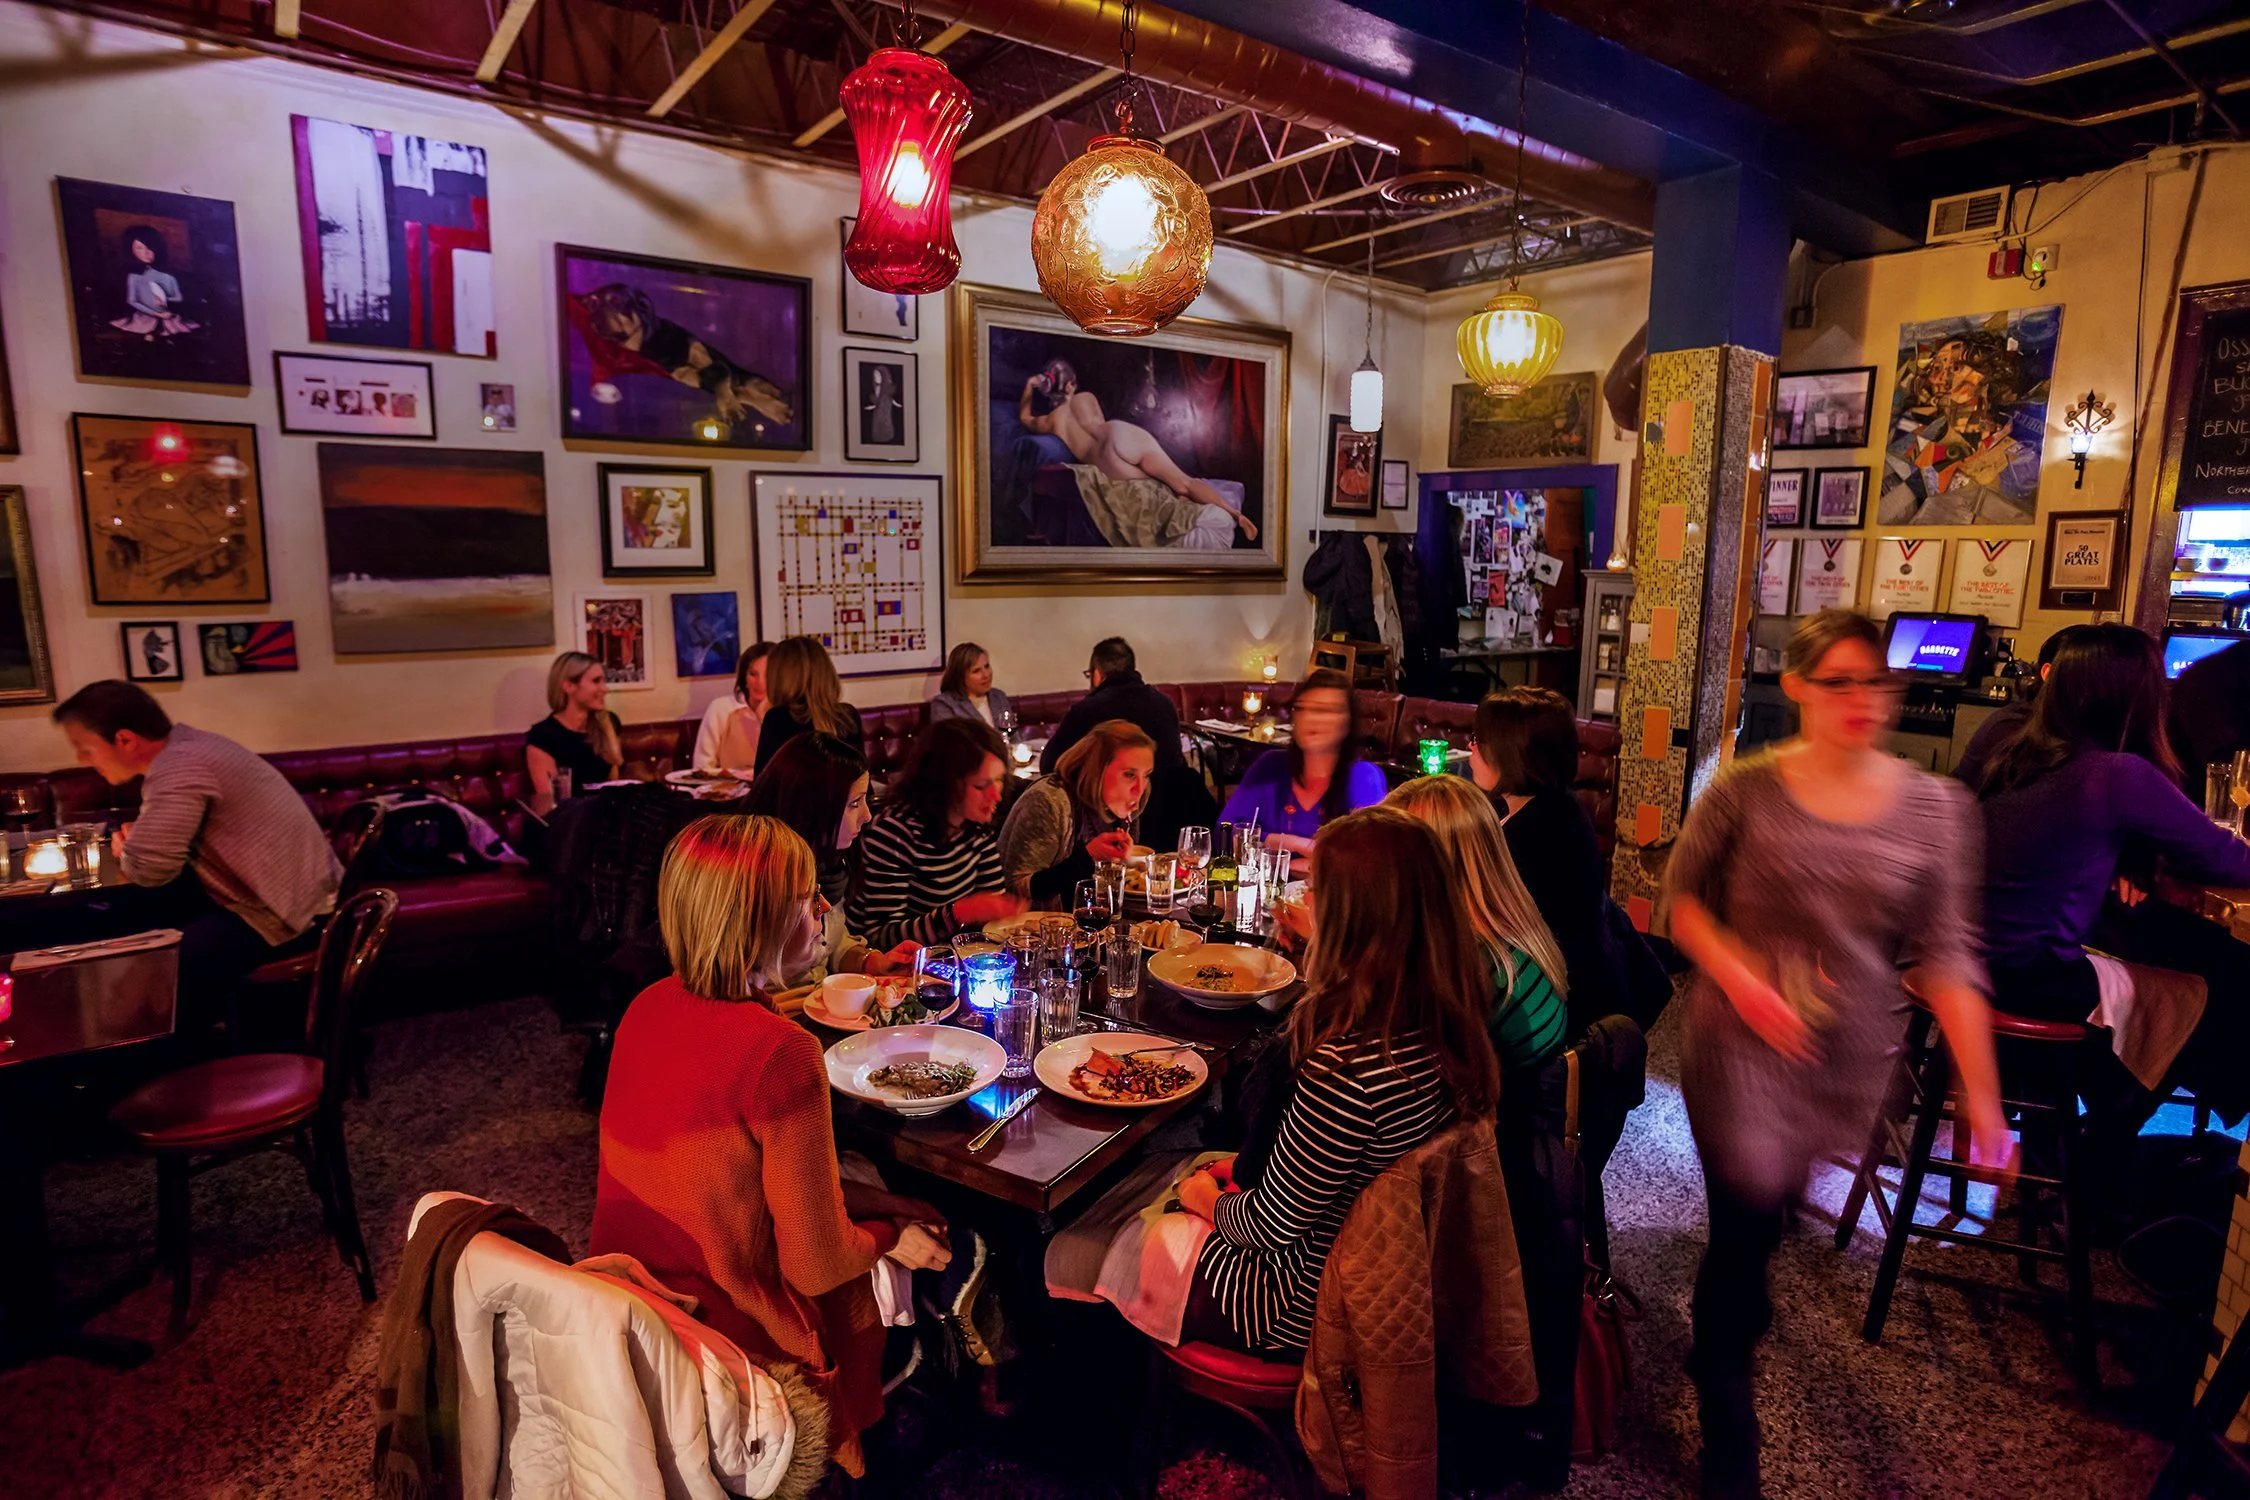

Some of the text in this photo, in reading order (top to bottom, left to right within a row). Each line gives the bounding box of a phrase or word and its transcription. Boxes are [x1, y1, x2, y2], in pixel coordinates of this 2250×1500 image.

[1771, 479, 1799, 492] INNER
[2078, 544, 2089, 552] 50
[2066, 551, 2099, 559] GREAT
[2064, 558, 2099, 566] PLATES
